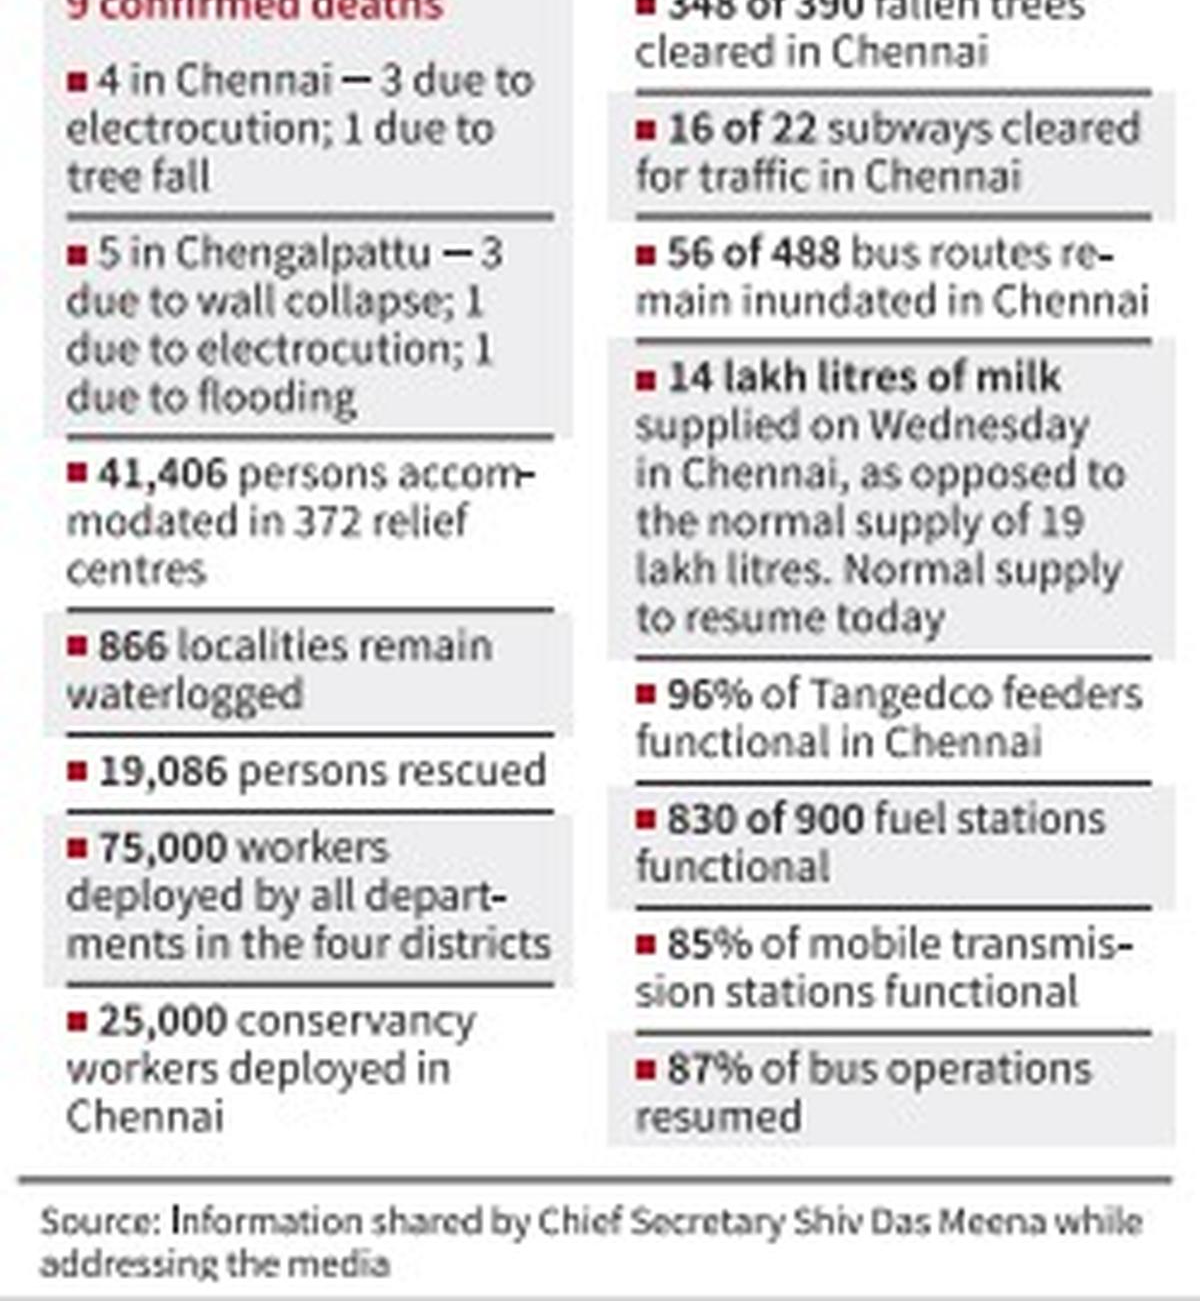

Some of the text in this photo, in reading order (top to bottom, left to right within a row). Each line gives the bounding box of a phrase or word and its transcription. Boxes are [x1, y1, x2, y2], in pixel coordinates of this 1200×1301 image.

[635, 33, 987, 69] cleared in Chennai
[97, 61, 535, 98] 4 in Chennai 3 due to
[669, 108, 1140, 154] 16 of 22 subways cleared
[67, 156, 209, 194] tree fall
[100, 233, 503, 281] 5 in Chengalpattu 3
[668, 235, 714, 269] 56
[722, 233, 762, 269] of
[771, 235, 841, 270] 488
[852, 234, 921, 270] bus
[931, 238, 1052, 270] routes
[669, 356, 1062, 394] 14 lakh litres of milk
[66, 376, 358, 425] due to flooding
[635, 406, 1090, 450] supplied on Wednesday
[98, 456, 228, 496] 41,406
[239, 463, 388, 497] persons
[68, 500, 469, 538] modated in 372 relief
[66, 556, 207, 585] centres
[637, 551, 1122, 594] lakh litres. Normal supply
[98, 626, 492, 662] 866 localities remain
[66, 674, 303, 720] waterlogged
[667, 674, 1143, 719] 96% of Tangedco feeders
[100, 752, 546, 795] 19,086 persons rescued
[667, 798, 1106, 836] 830 of 900 fuel stations
[99, 828, 390, 869] 75,000 workers
[636, 847, 830, 883] functional
[68, 924, 551, 961] ments in the four districts
[668, 926, 753, 960] 85%
[761, 924, 800, 960] of
[810, 924, 941, 960] mobile
[635, 972, 1077, 1009] sion stations functional
[99, 1003, 476, 1046] 25,000 conservancy
[66, 1097, 223, 1134] Chennai
[637, 1097, 802, 1134] resumed
[41, 1203, 1143, 1244] Source: Information shared by Chief Secretary Shiv Das Meena while
[40, 1248, 390, 1282] addressing the media
